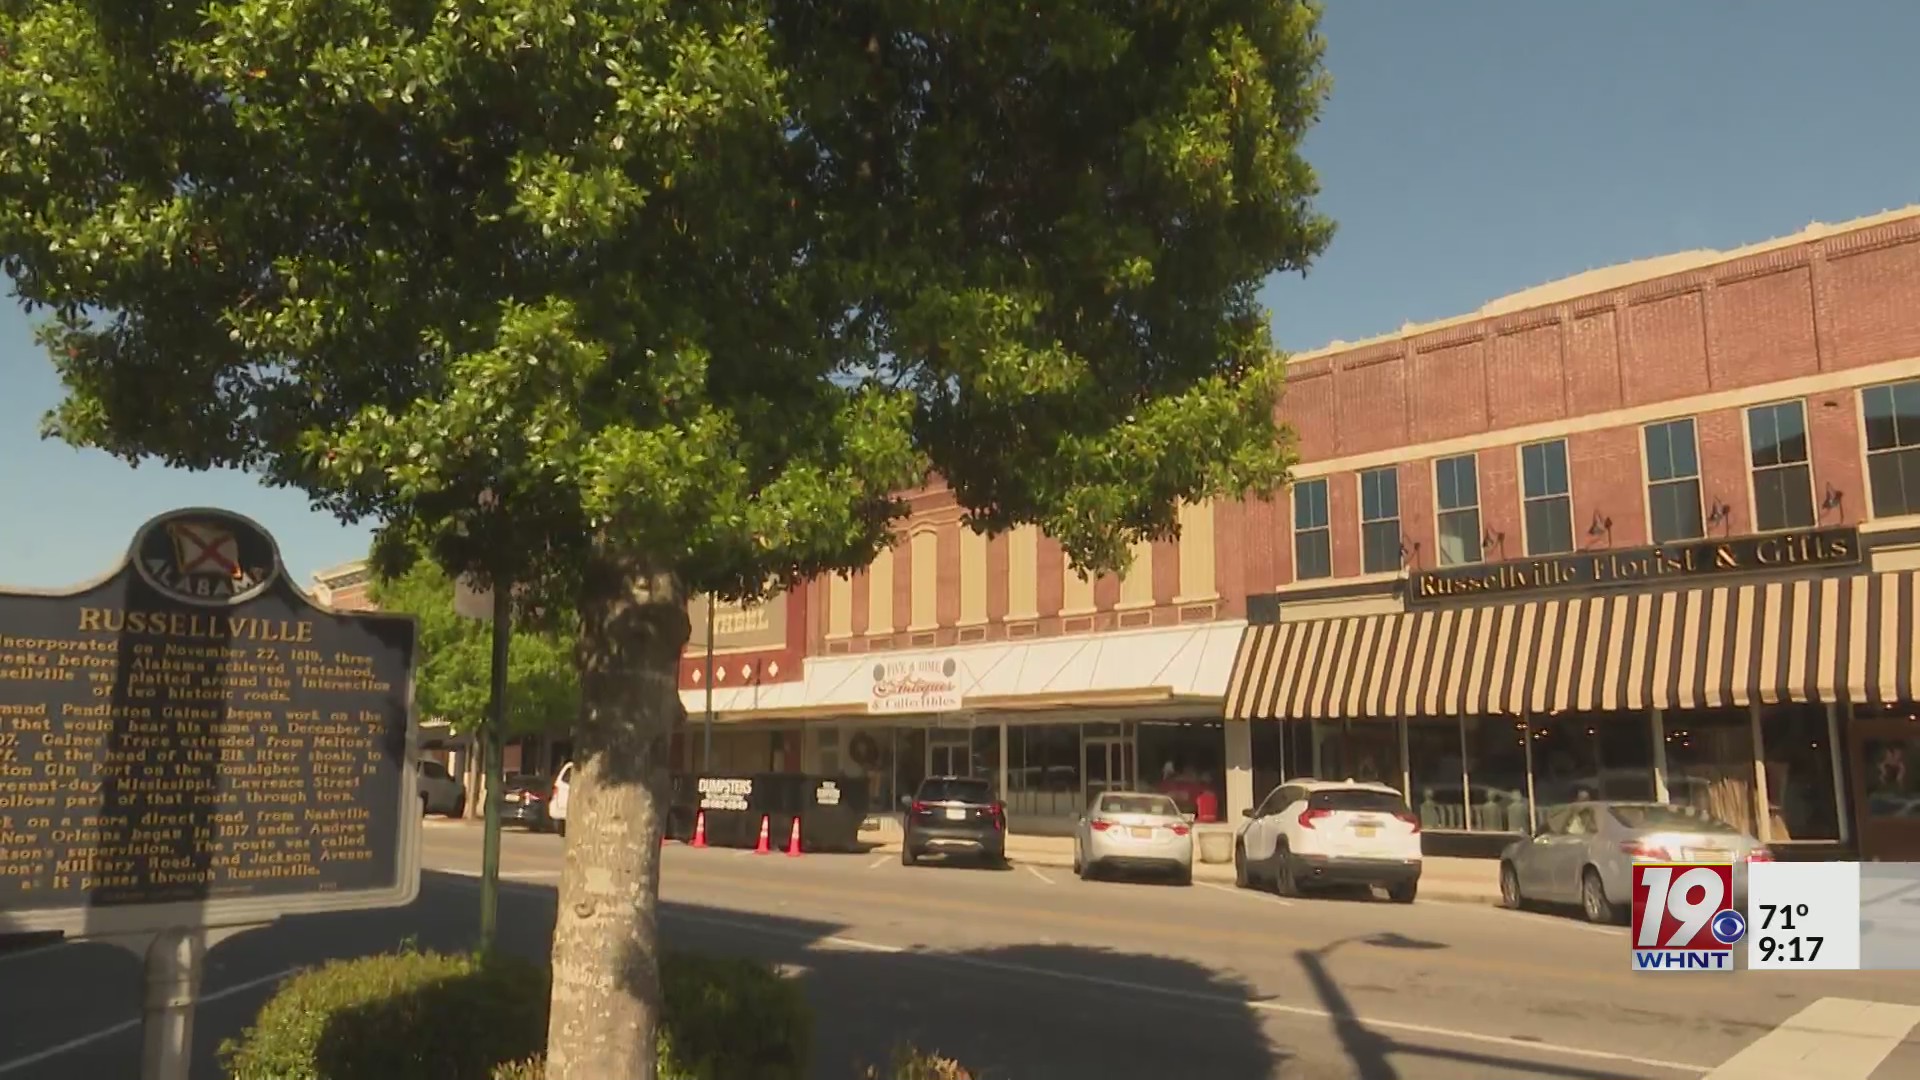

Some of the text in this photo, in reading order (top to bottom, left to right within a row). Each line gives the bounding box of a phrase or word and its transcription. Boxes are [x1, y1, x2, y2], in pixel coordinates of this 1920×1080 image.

[1420, 535, 1848, 596] Russellville Florist & Gifts
[78, 606, 313, 643] RUSSELLVILLE
[58, 653, 119, 669] before
[131, 657, 205, 673] Alabama
[216, 661, 285, 674] achieved
[134, 643, 153, 654] on
[166, 643, 246, 659] November
[335, 652, 373, 666] three
[129, 670, 192, 688] platted
[202, 675, 258, 688] around
[267, 674, 291, 688] the
[93, 685, 113, 697] of
[127, 685, 156, 698] two
[169, 687, 233, 700] historic
[62, 703, 151, 718] Pendleton
[162, 706, 218, 719] Gaines
[227, 707, 272, 722] began
[285, 709, 320, 721] work
[330, 712, 348, 722] on
[359, 710, 382, 723] the
[12, 718, 51, 731] that
[64, 720, 114, 732] would
[128, 720, 168, 733] bear
[177, 721, 201, 734] his
[210, 724, 249, 734] name
[260, 723, 278, 734] on
[288, 722, 360, 735] December
[120, 734, 170, 747] Trace
[180, 734, 256, 748] extended
[266, 736, 303, 748] from
[34, 750, 53, 762] at
[64, 749, 93, 761] the
[104, 750, 146, 762] head
[157, 750, 178, 762] of
[187, 750, 213, 762] the
[256, 750, 297, 762] River
[368, 751, 382, 761] to
[44, 763, 76, 776] Gin
[92, 763, 131, 776] Port
[143, 766, 164, 777] on
[175, 763, 201, 776] the
[313, 763, 353, 775] River
[232, 778, 304, 790] Lawrence
[313, 776, 360, 788] Street
[698, 778, 752, 794] DUMPSTERS
[66, 794, 104, 809] part
[118, 793, 137, 806] of
[147, 791, 182, 805] that
[194, 793, 237, 806] route
[247, 791, 306, 805] through
[27, 818, 50, 828] on
[83, 815, 128, 827] more
[141, 812, 195, 826] direct
[207, 811, 243, 824] road
[257, 810, 294, 823] from
[304, 809, 370, 821] Nashville
[1, 831, 37, 844] New
[52, 829, 120, 843] Orleans
[131, 829, 182, 842] began
[258, 824, 300, 836] under
[309, 822, 366, 836] Andrew
[194, 841, 224, 853] The
[233, 838, 276, 851] route
[285, 840, 310, 850] was
[321, 834, 365, 848] called
[56, 857, 135, 873] Military
[211, 853, 241, 866] and
[250, 850, 311, 864] Jackson
[320, 848, 372, 862] Avenue
[81, 873, 138, 891] passes
[150, 868, 216, 885] through
